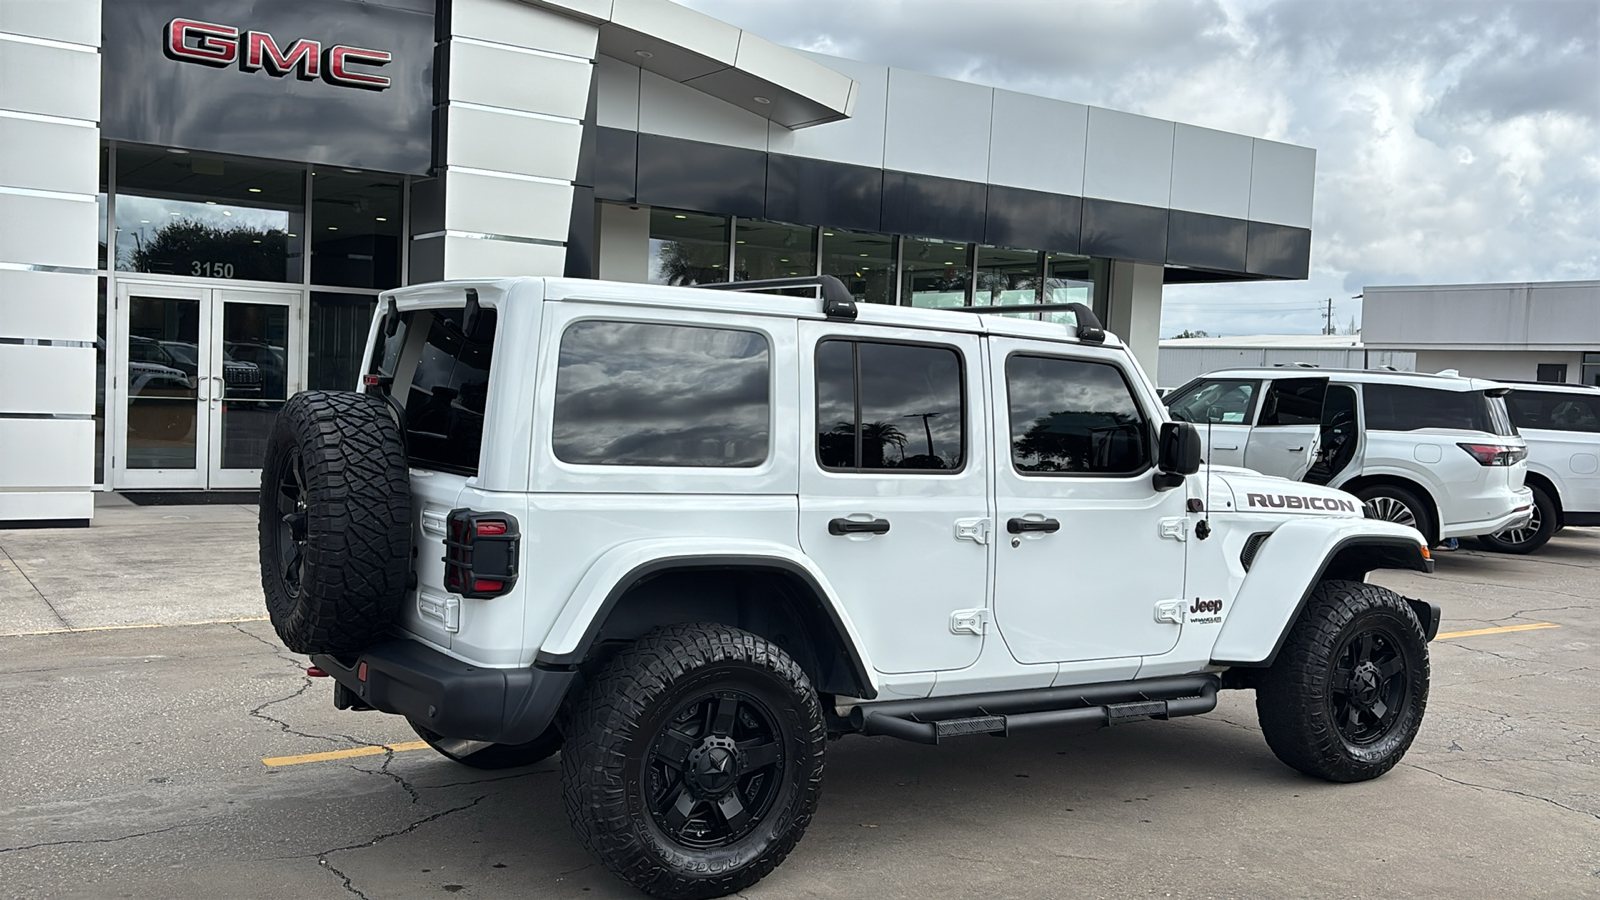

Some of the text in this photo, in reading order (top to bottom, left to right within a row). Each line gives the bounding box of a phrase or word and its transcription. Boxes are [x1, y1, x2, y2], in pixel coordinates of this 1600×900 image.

[165, 18, 391, 89] GMC
[191, 261, 234, 278] 3150
[1247, 493, 1355, 512] RUBICON
[1190, 597, 1223, 615] Jeep
